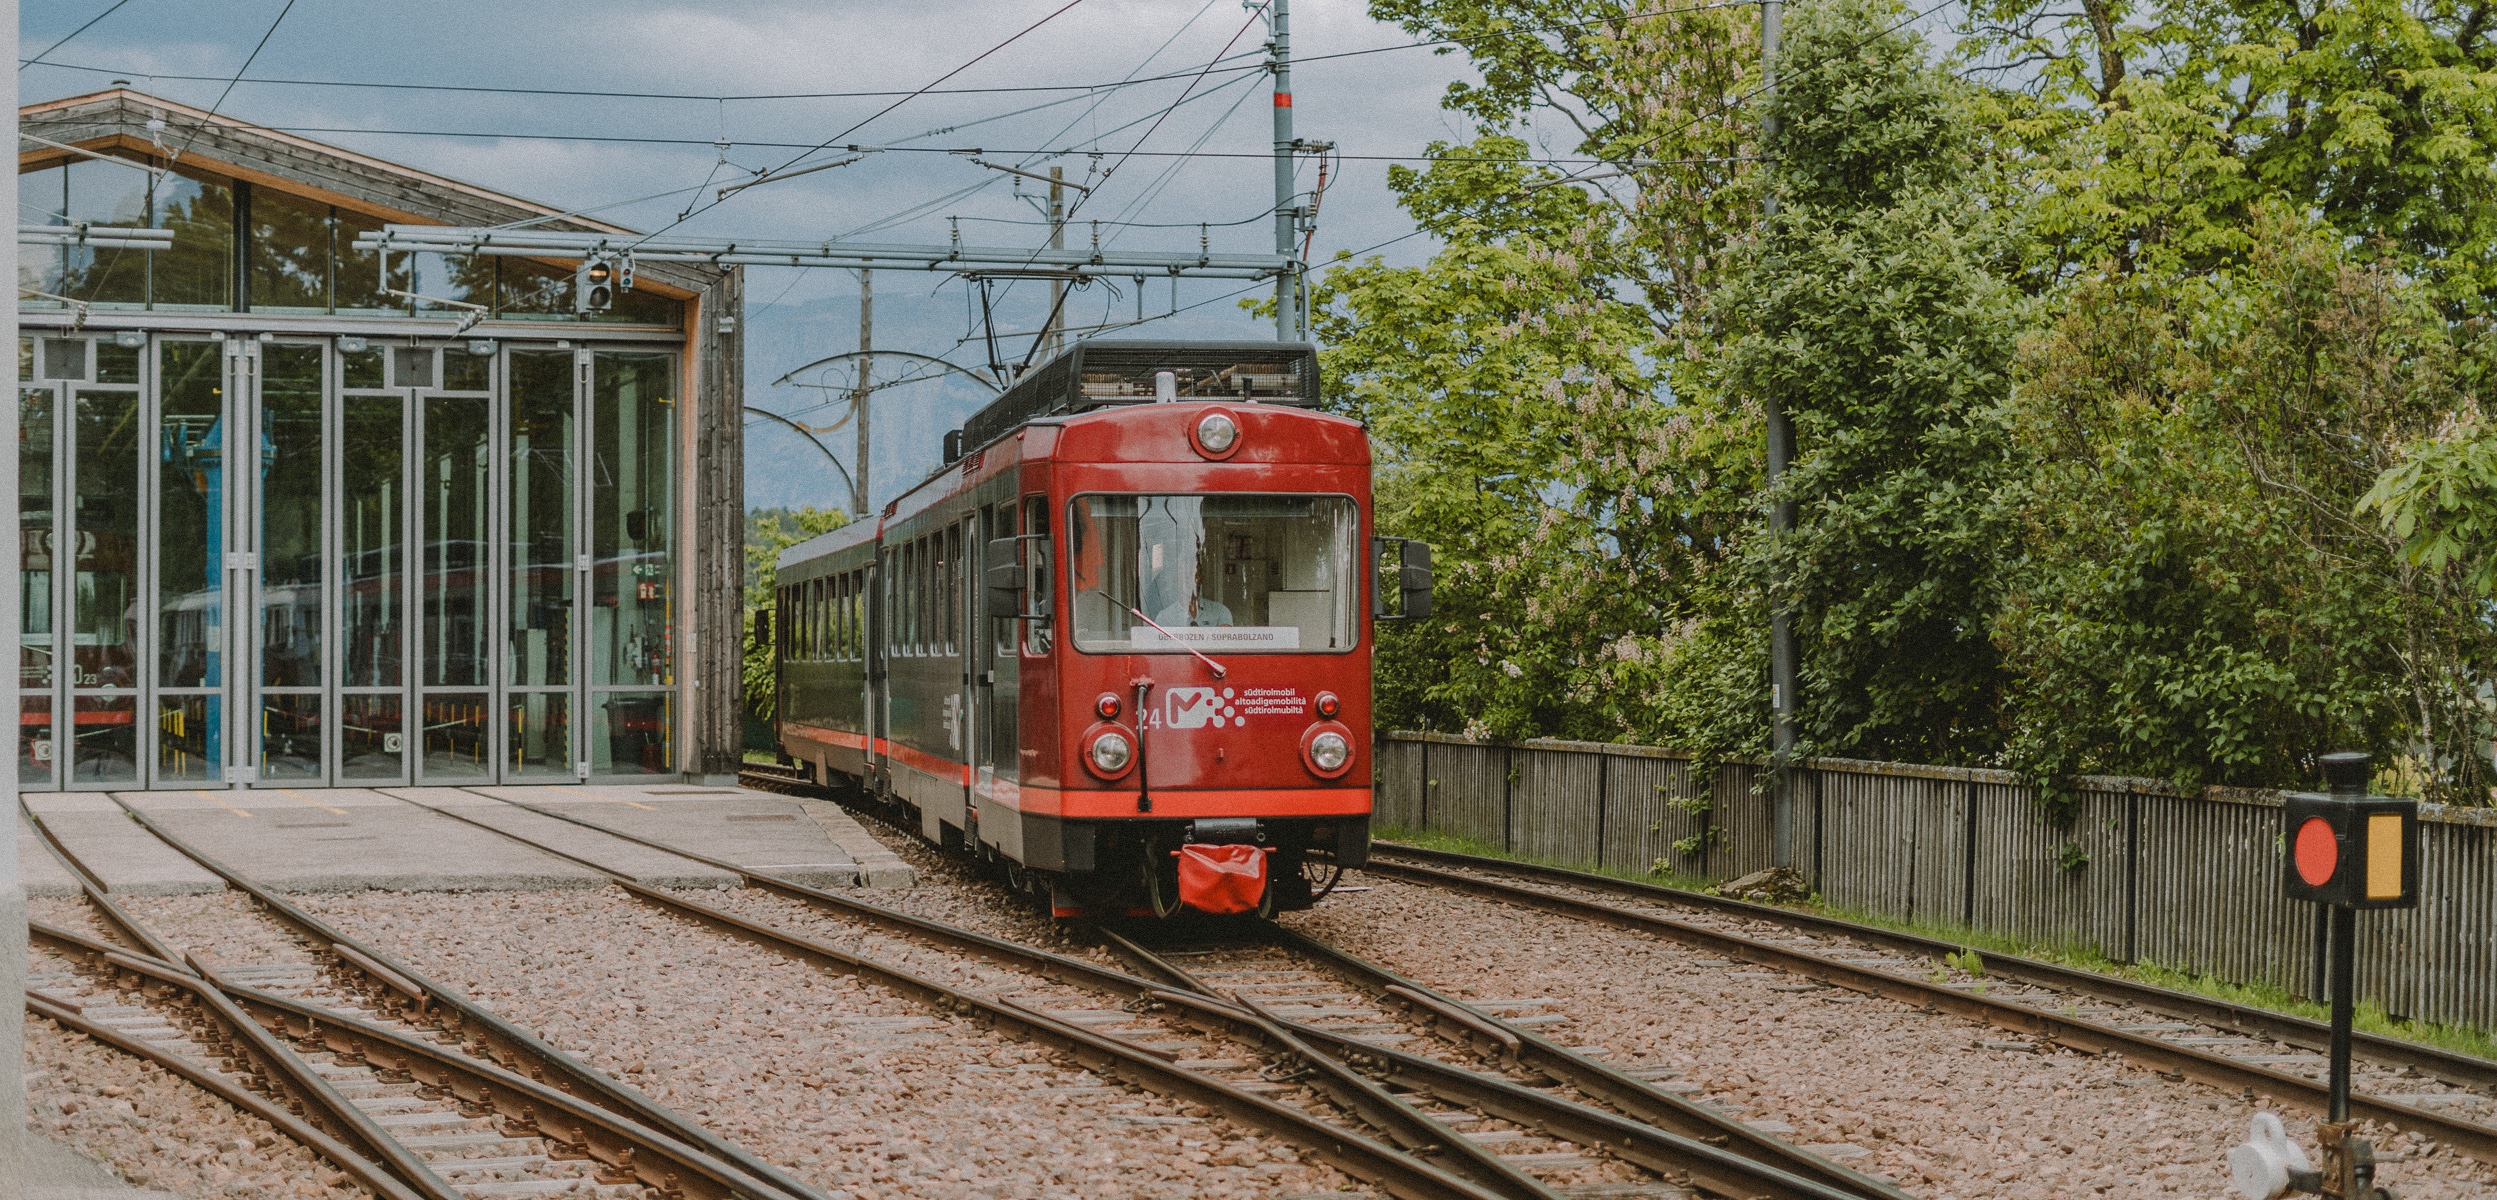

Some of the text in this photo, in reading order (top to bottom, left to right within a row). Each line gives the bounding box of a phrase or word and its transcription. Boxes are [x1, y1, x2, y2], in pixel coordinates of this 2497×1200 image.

[1211, 633, 1274, 641] SOPRABOLZANO
[83, 673, 97, 685] 23
[1243, 687, 1296, 697] südtirolmobil
[1234, 697, 1307, 706] altoadigemobilità
[1135, 708, 1161, 729] 24
